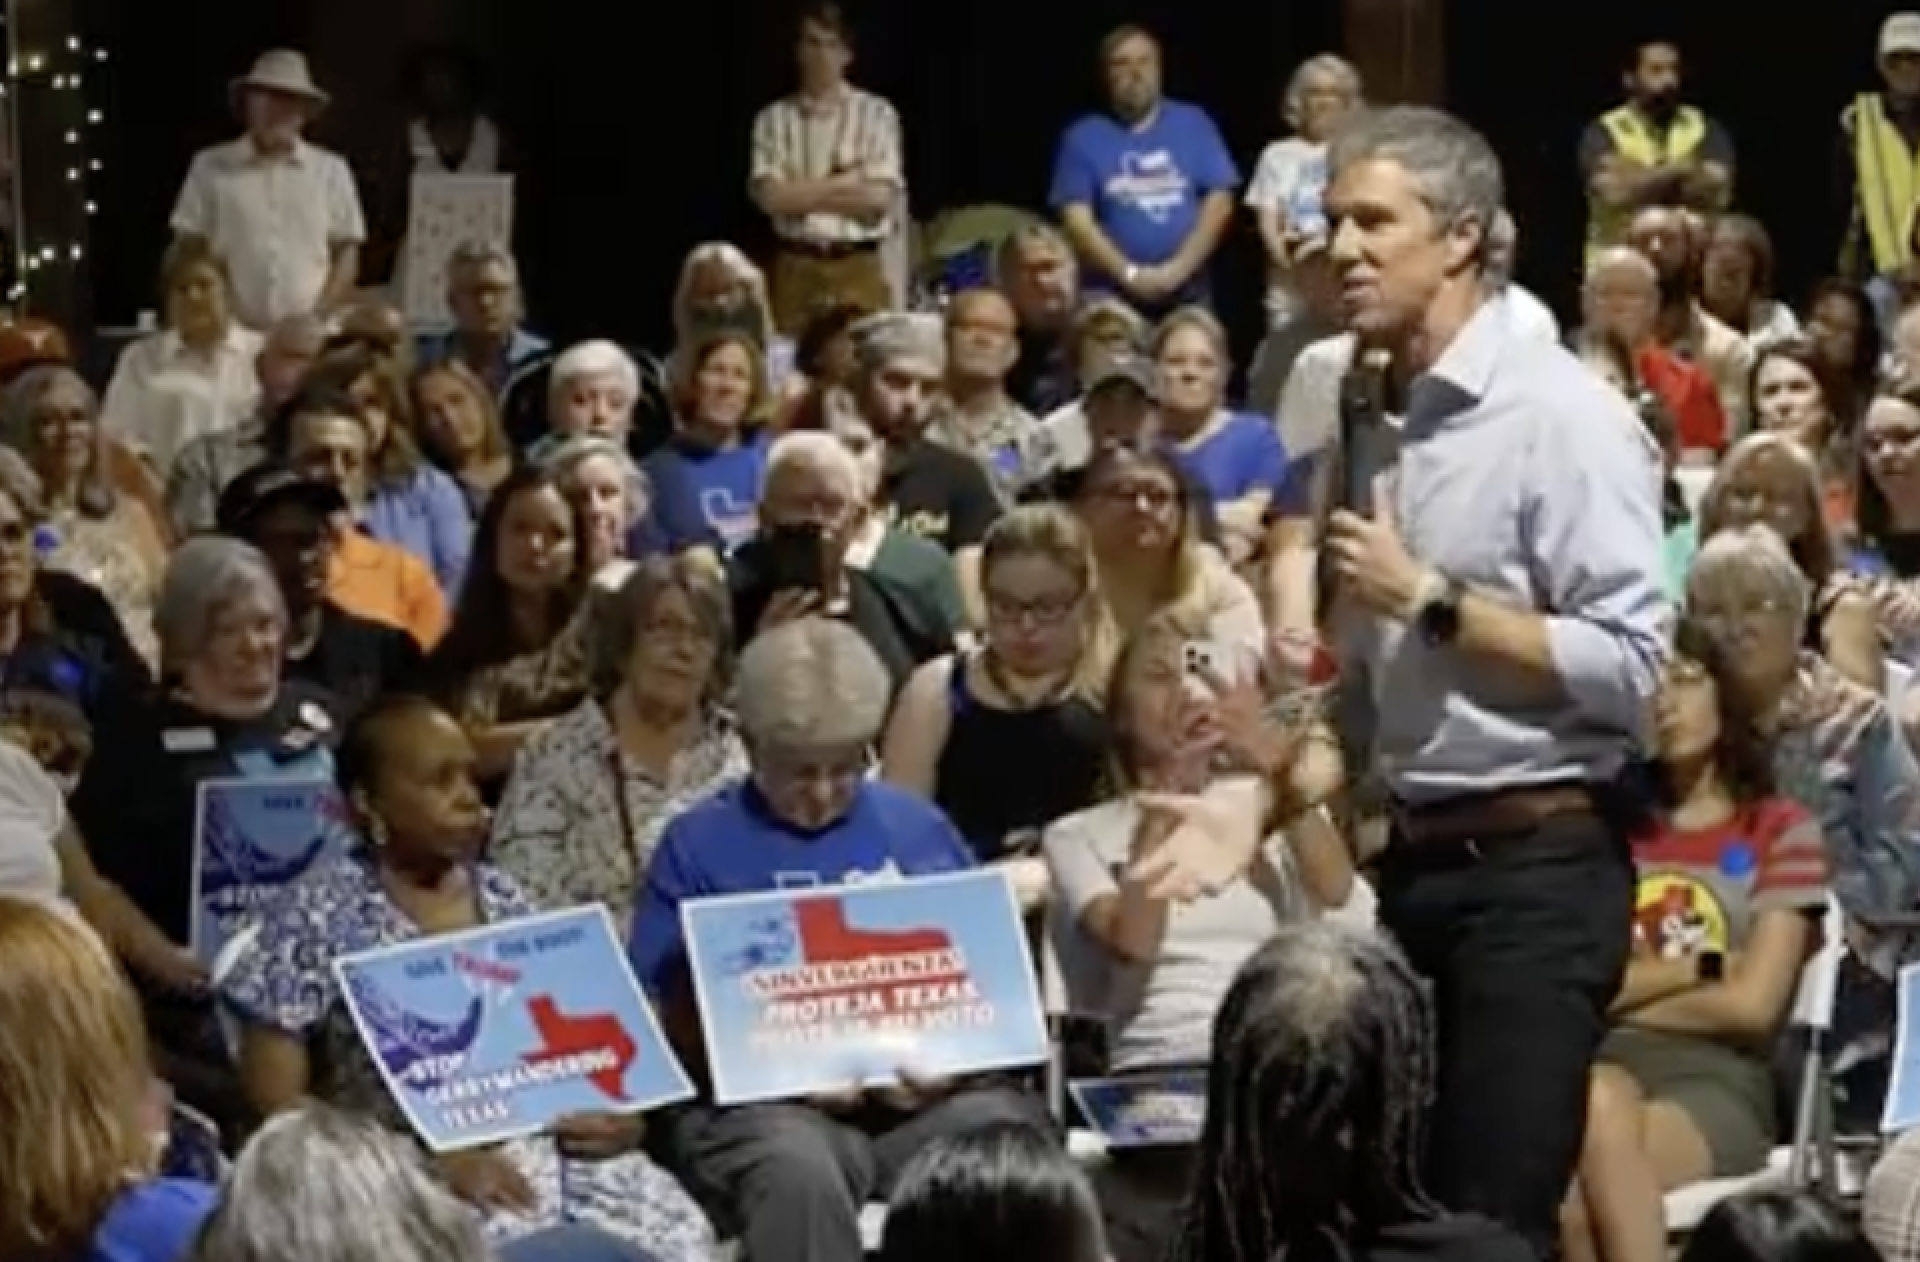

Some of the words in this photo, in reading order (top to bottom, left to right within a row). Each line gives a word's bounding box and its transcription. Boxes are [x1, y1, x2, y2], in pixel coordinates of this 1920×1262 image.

[893, 978, 982, 1008] TEXAS
[404, 1052, 466, 1082] STOP
[441, 1099, 510, 1130] TEXAS
